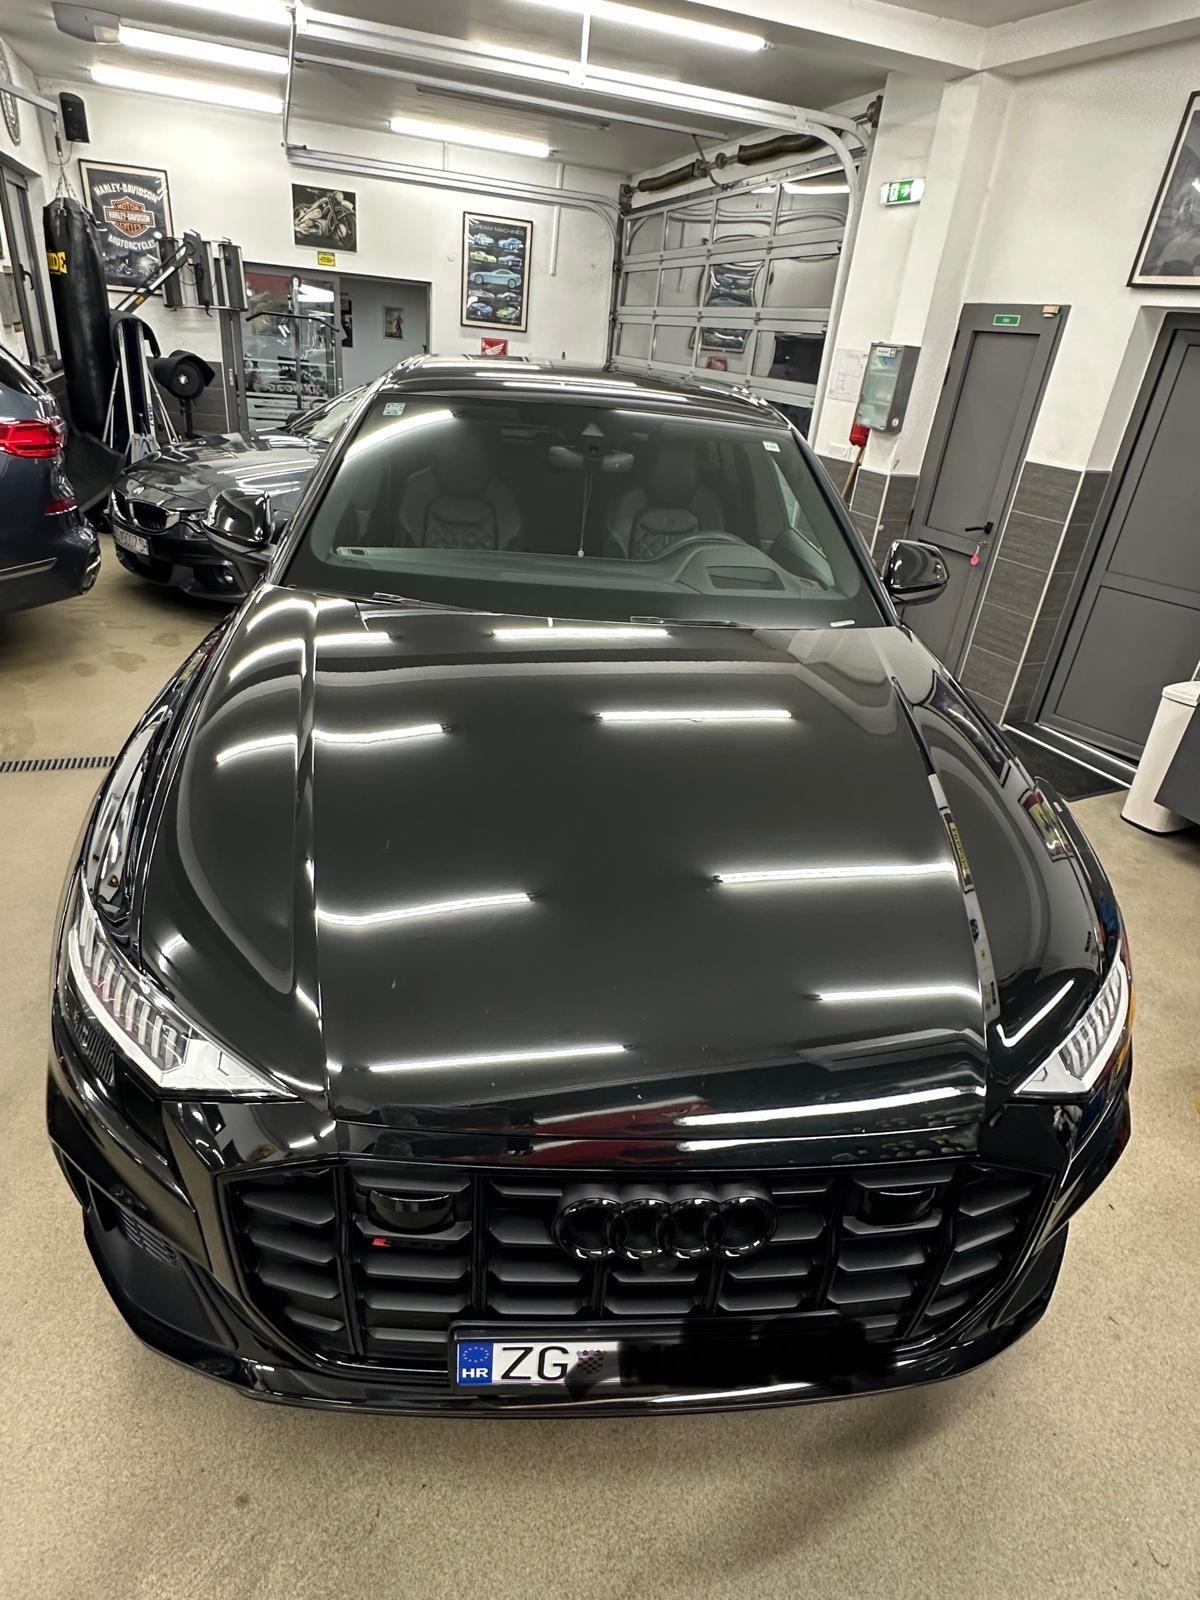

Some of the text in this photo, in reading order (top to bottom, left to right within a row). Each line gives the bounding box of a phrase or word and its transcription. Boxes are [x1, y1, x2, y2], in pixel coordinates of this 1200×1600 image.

[93, 182, 159, 203] HARLEY-DAVIDSON
[108, 210, 151, 223] HARLEY-DAVIDSON
[108, 234, 156, 251] MOTORCYCLES
[462, 1368, 489, 1378] HR
